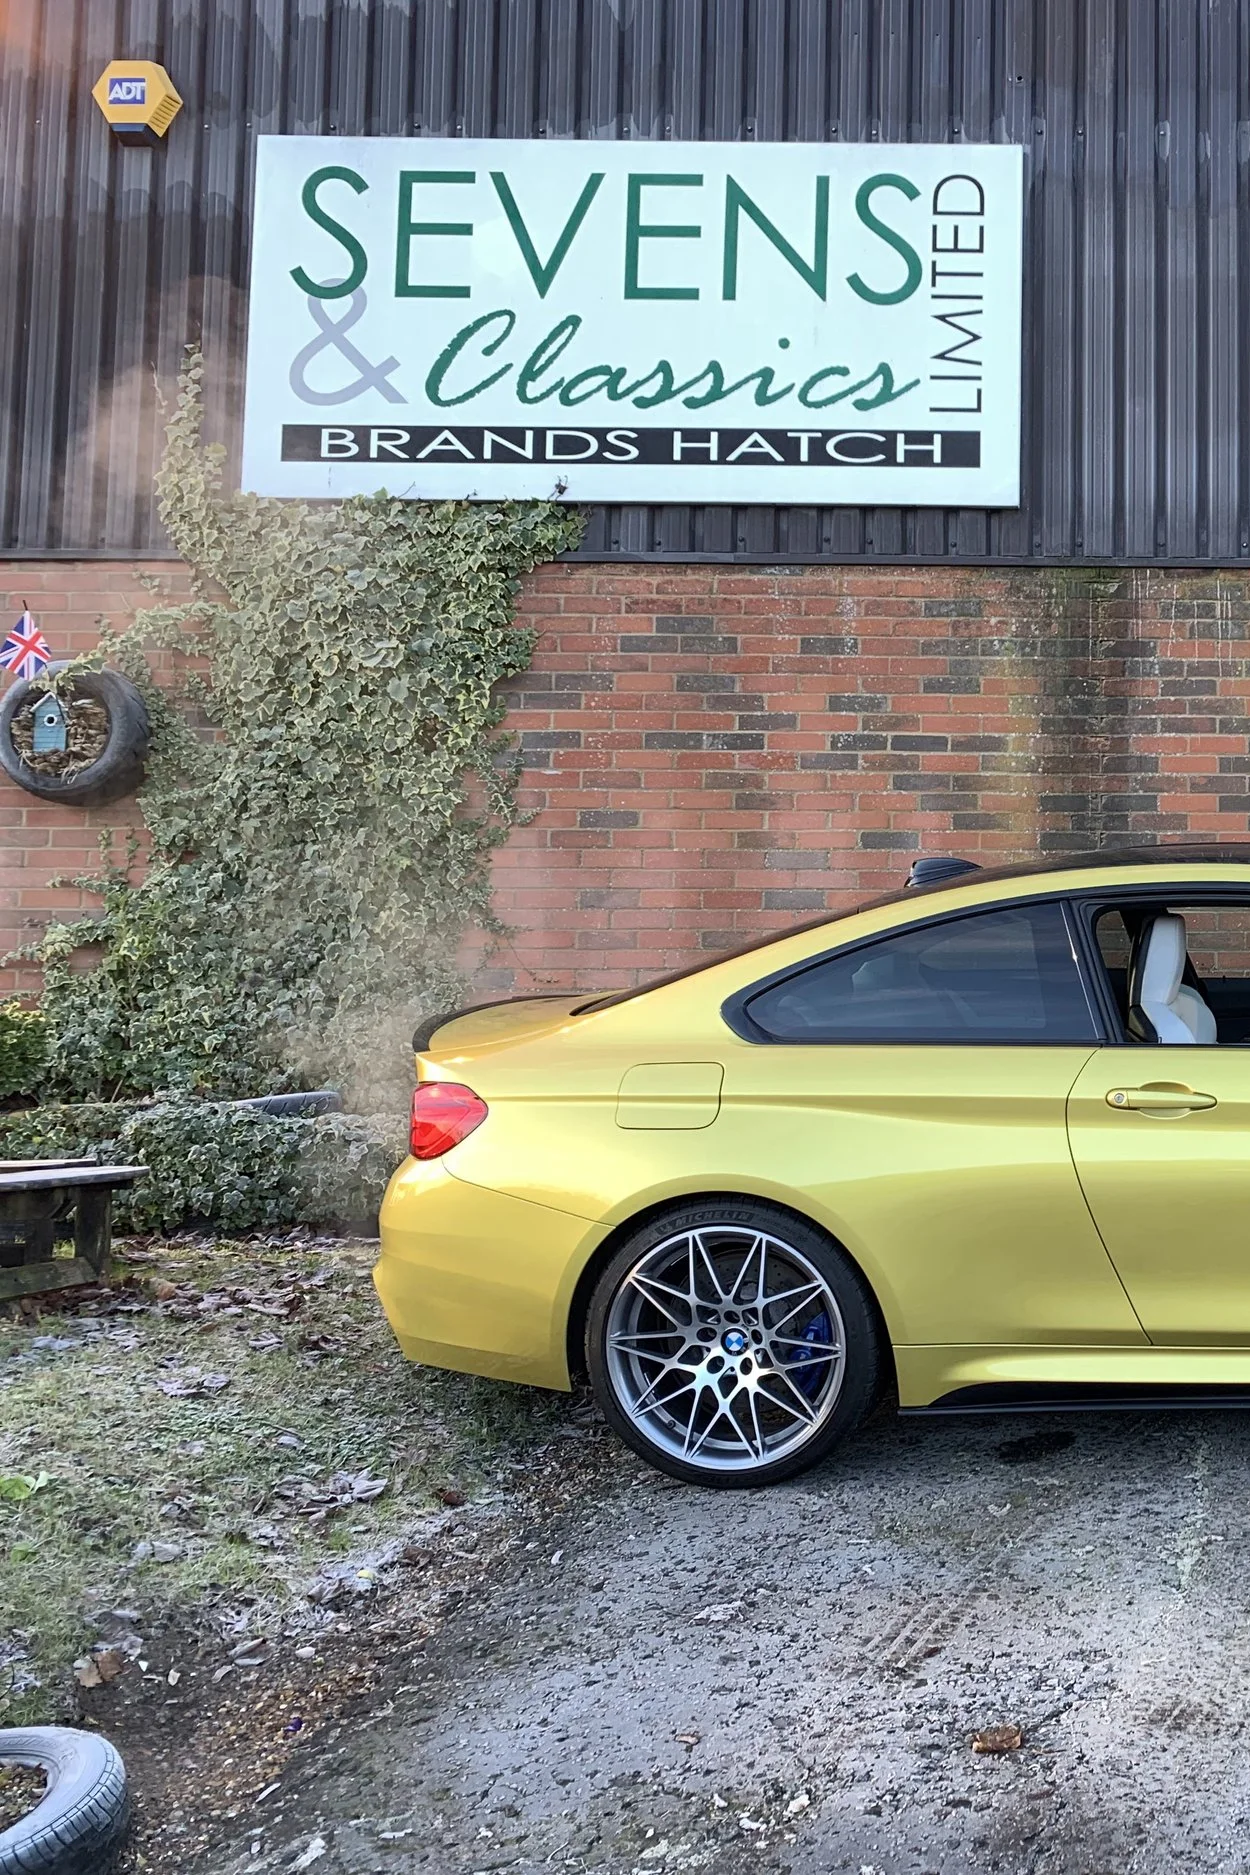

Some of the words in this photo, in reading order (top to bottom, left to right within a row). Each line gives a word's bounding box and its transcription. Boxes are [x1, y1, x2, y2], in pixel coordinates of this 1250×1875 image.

[109, 81, 146, 100] ADT
[289, 166, 923, 305] SEVENS
[929, 174, 985, 413] LIMITED
[289, 278, 409, 406] &
[425, 309, 921, 411] Classics
[320, 428, 640, 461] BRANDS
[673, 431, 942, 463] HATCH
